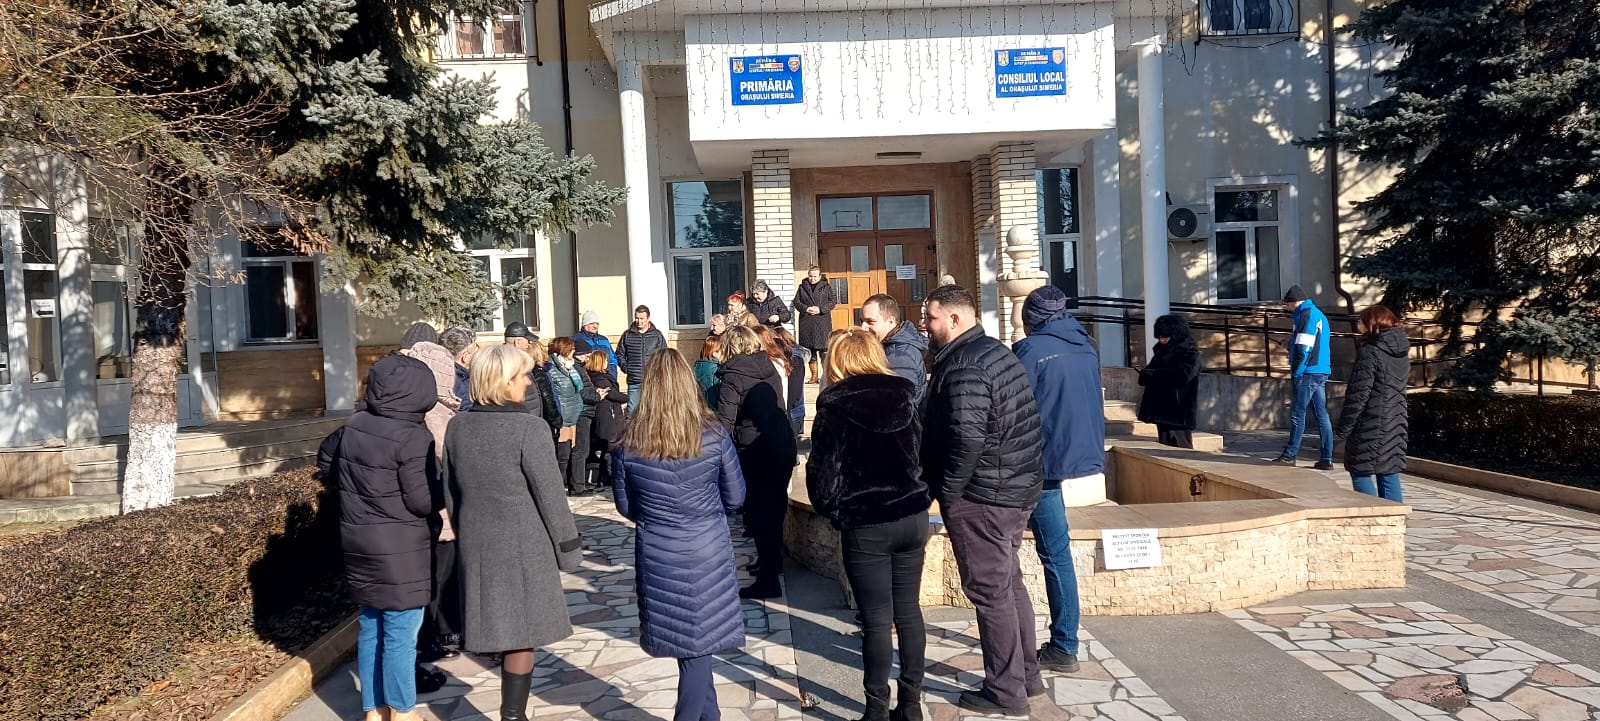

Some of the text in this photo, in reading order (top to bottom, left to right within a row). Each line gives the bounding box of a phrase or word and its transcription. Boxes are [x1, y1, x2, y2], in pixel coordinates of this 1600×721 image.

[998, 71, 1064, 84] CONSILIUL LOCAL
[740, 78, 794, 92] PRIMĂRIA
